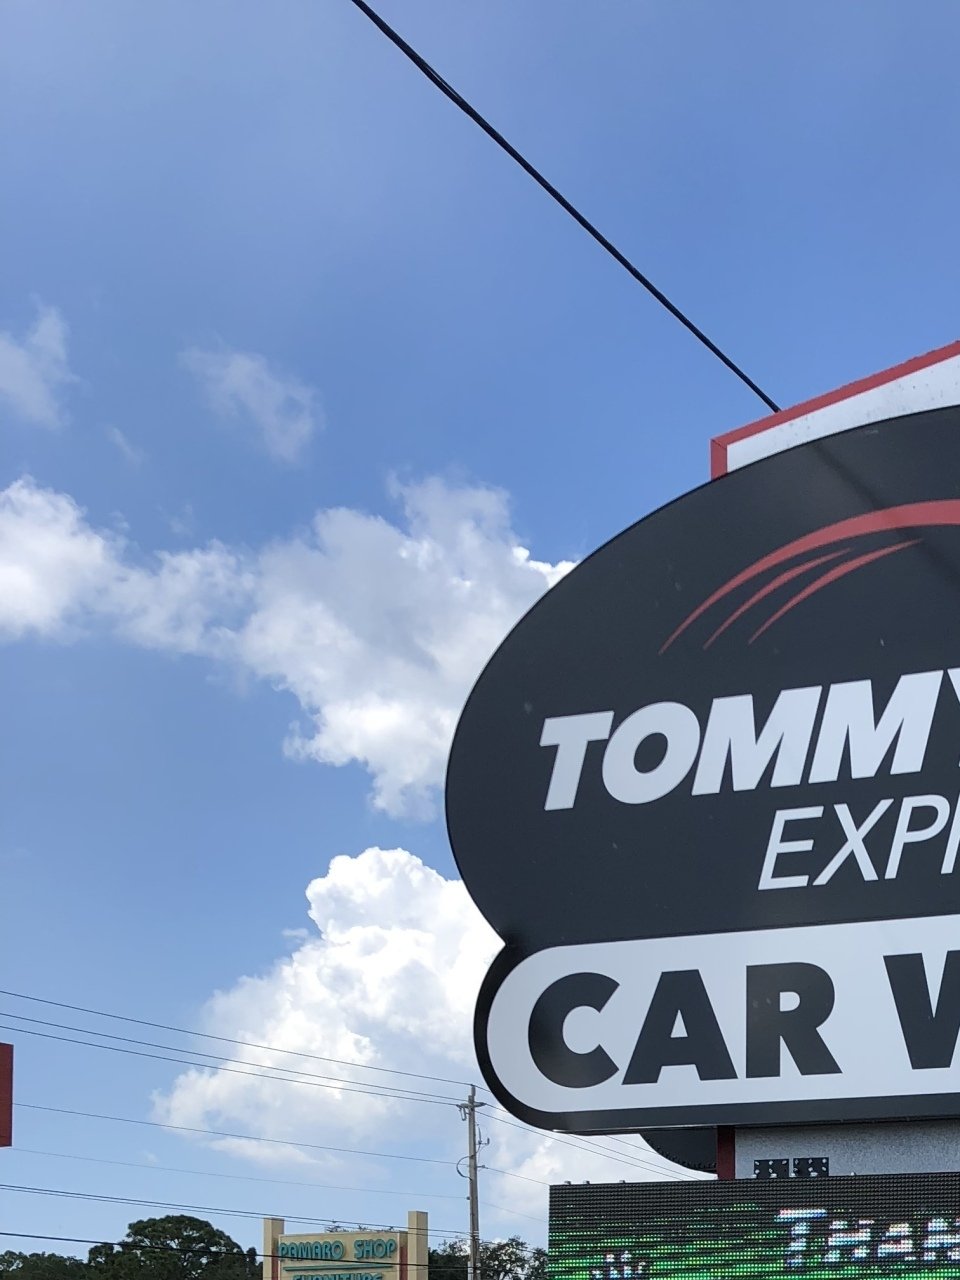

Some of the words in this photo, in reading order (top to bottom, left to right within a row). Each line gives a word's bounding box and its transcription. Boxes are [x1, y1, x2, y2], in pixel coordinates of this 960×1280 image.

[527, 965, 842, 1088] CAR
[279, 1240, 344, 1262] PAMARO
[353, 1239, 397, 1260] SHOP
